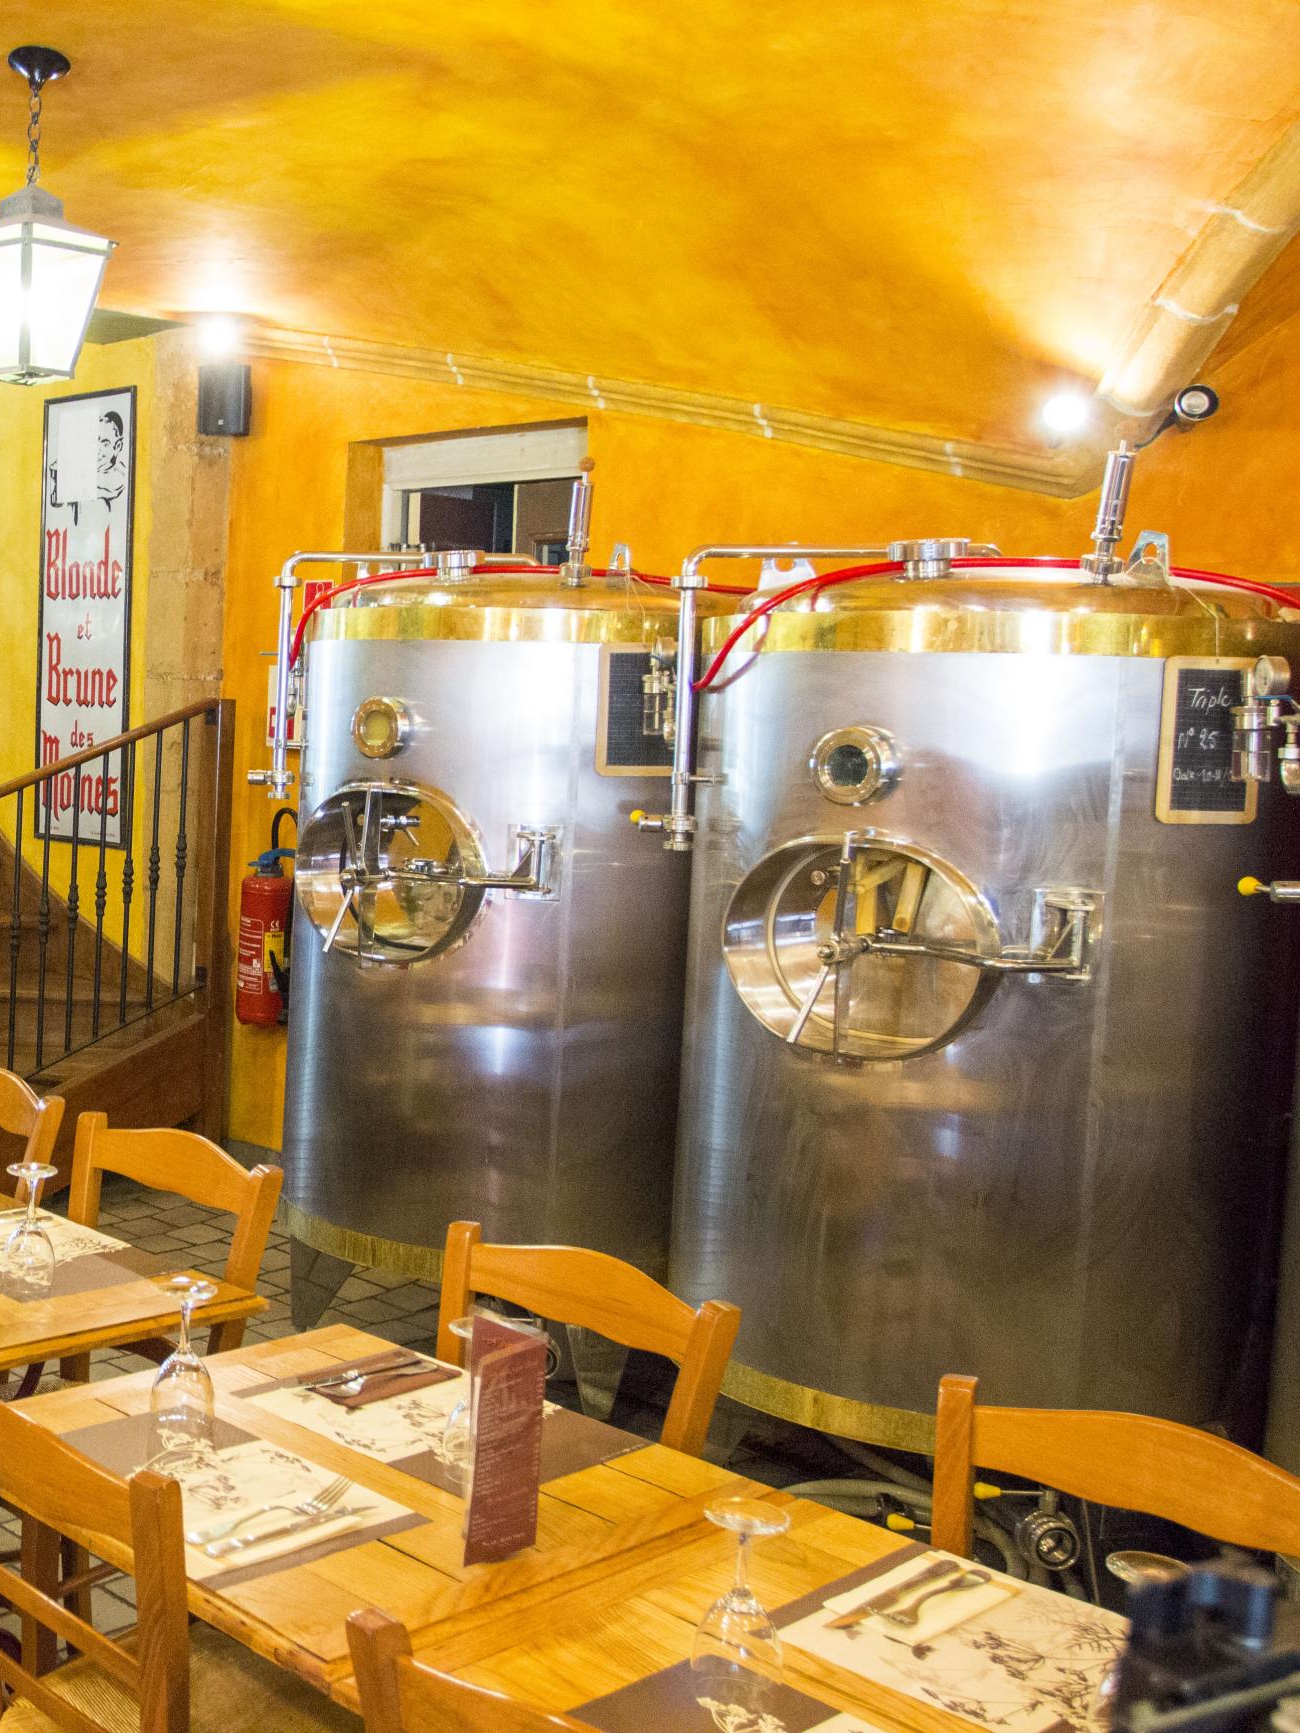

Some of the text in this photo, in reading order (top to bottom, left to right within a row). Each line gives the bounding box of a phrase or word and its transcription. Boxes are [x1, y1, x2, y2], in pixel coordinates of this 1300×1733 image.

[46, 524, 123, 601] Blonde
[76, 610, 92, 640] et
[46, 632, 118, 709] Brune
[70, 719, 94, 748] des
[42, 729, 119, 822] Mones
